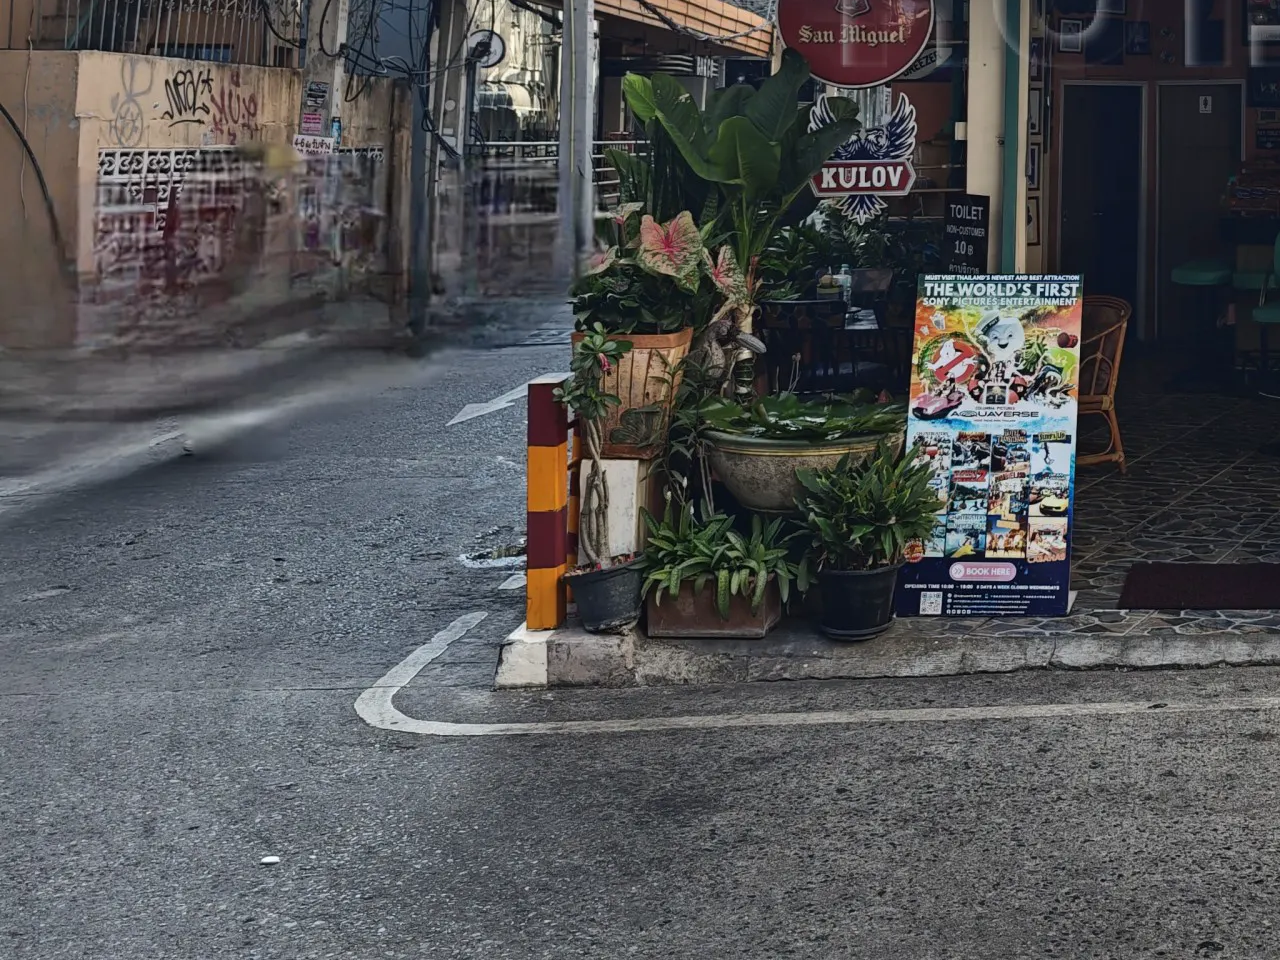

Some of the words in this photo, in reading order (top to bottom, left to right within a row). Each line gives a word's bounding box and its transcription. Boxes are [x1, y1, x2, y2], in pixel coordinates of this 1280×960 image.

[798, 24, 834, 45] San
[839, 23, 906, 47] Miguel
[821, 165, 904, 189] KULOV
[949, 204, 984, 221] TOILET
[954, 240, 966, 255] 10
[924, 283, 954, 297] THE
[1036, 283, 1080, 297] FIRST
[922, 297, 950, 306] SONY
[952, 297, 998, 306] PICTURES
[1000, 297, 1078, 306] ENTERTAINMENT
[966, 568, 989, 576] BOOK
[991, 568, 1011, 576] HERE
